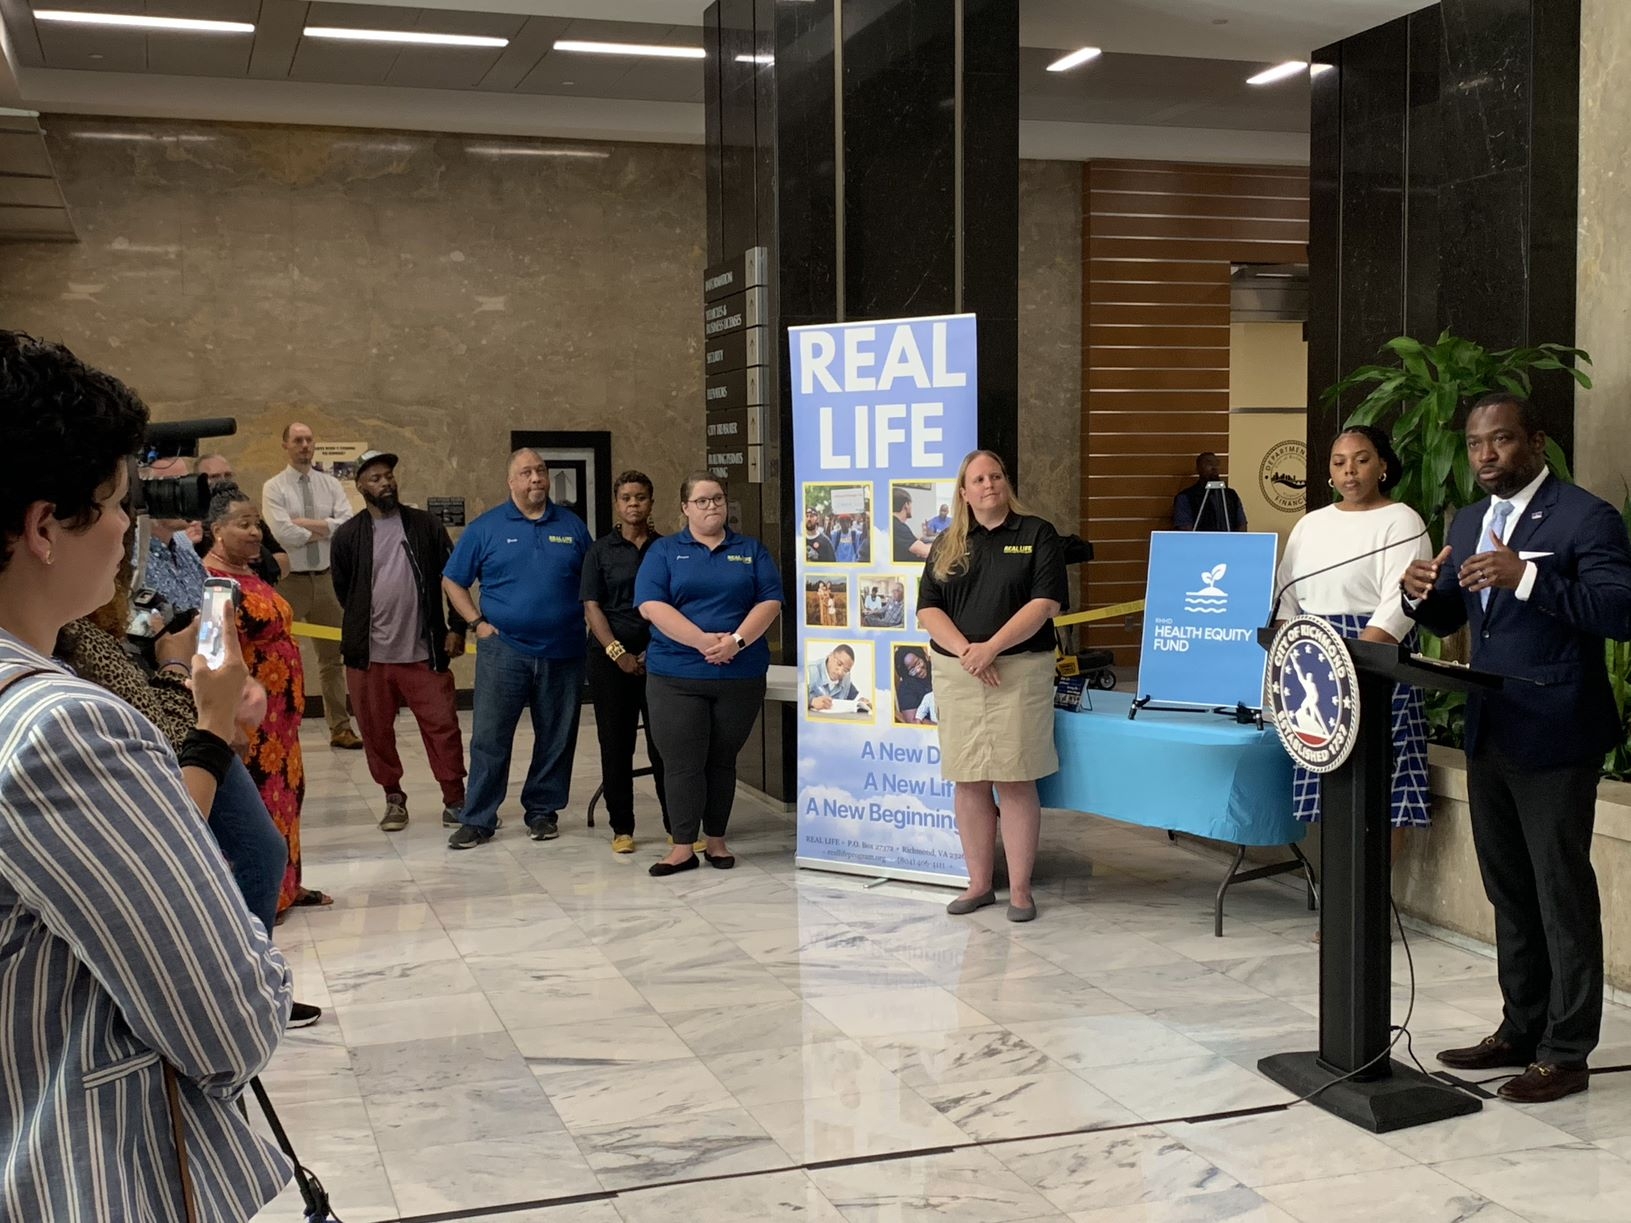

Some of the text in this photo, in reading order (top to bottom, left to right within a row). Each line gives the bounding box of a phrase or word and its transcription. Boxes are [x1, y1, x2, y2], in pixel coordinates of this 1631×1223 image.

[799, 322, 967, 394] REAL
[819, 402, 944, 470] LIFE
[1265, 446, 1306, 471] DEPARTMEN
[1153, 639, 1189, 652] FUND
[1155, 626, 1252, 642] HEALTH EQUITY
[1274, 624, 1347, 678] CITY OF RICHMOND
[1277, 710, 1331, 762] ESTABLISHED
[861, 741, 875, 760] A
[879, 742, 923, 763] New
[863, 772, 953, 798] A New Lif
[806, 797, 819, 816] A
[823, 798, 866, 821] New
[806, 835, 822, 844] REAL
[824, 837, 840, 846] LIFE
[847, 839, 860, 848] P.O.
[862, 841, 874, 850] Box
[902, 846, 936, 857] Richmond,
[938, 850, 950, 859] VA
